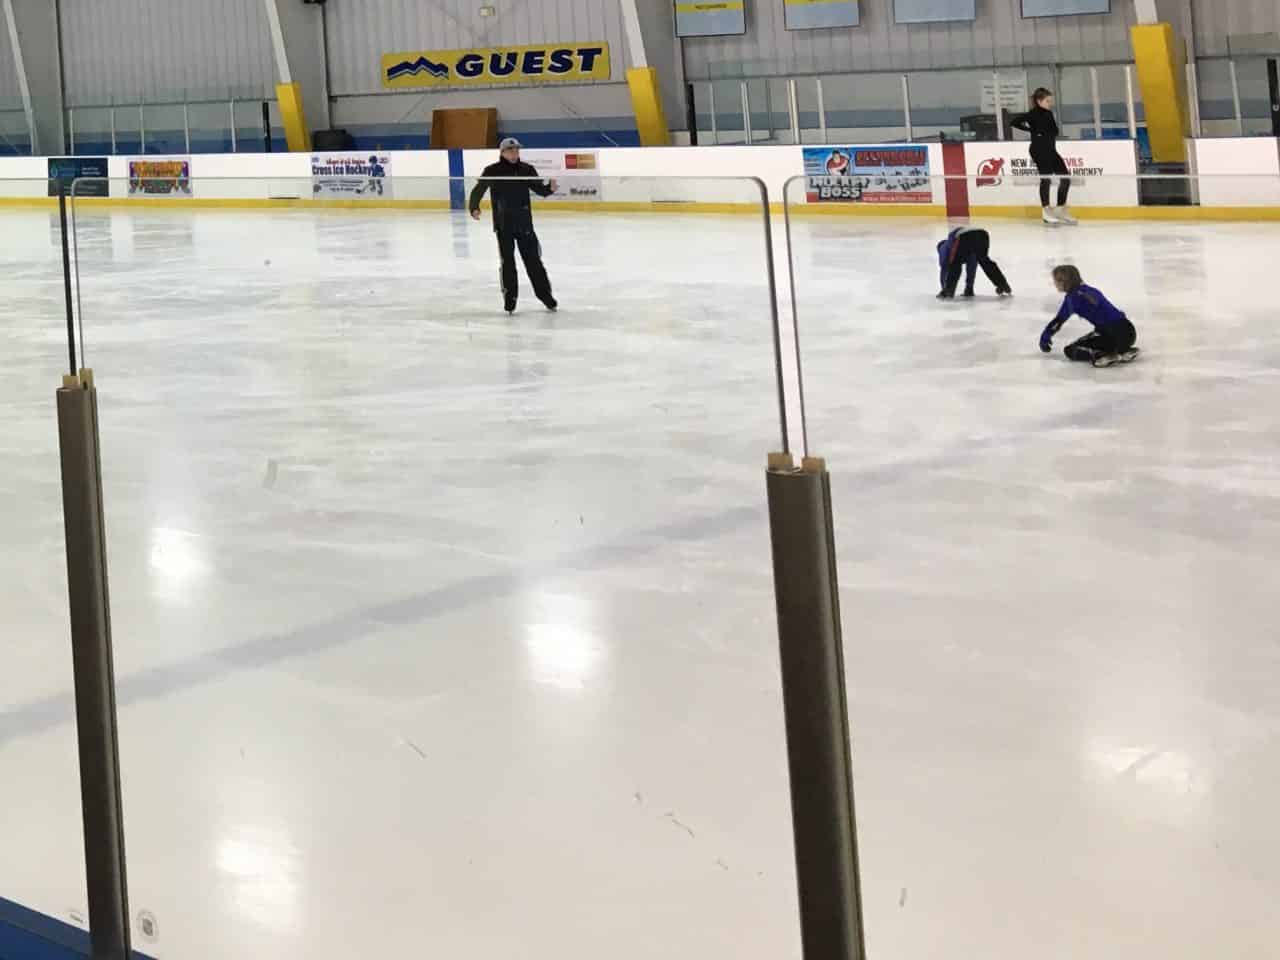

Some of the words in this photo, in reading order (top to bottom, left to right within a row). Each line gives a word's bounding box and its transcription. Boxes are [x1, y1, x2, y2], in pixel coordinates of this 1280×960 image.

[456, 47, 602, 77] GUEST
[312, 165, 332, 175] Cross
[345, 164, 372, 177] Hockey
[1072, 167, 1104, 177] HOCKEY
[820, 186, 861, 198] BOSS
